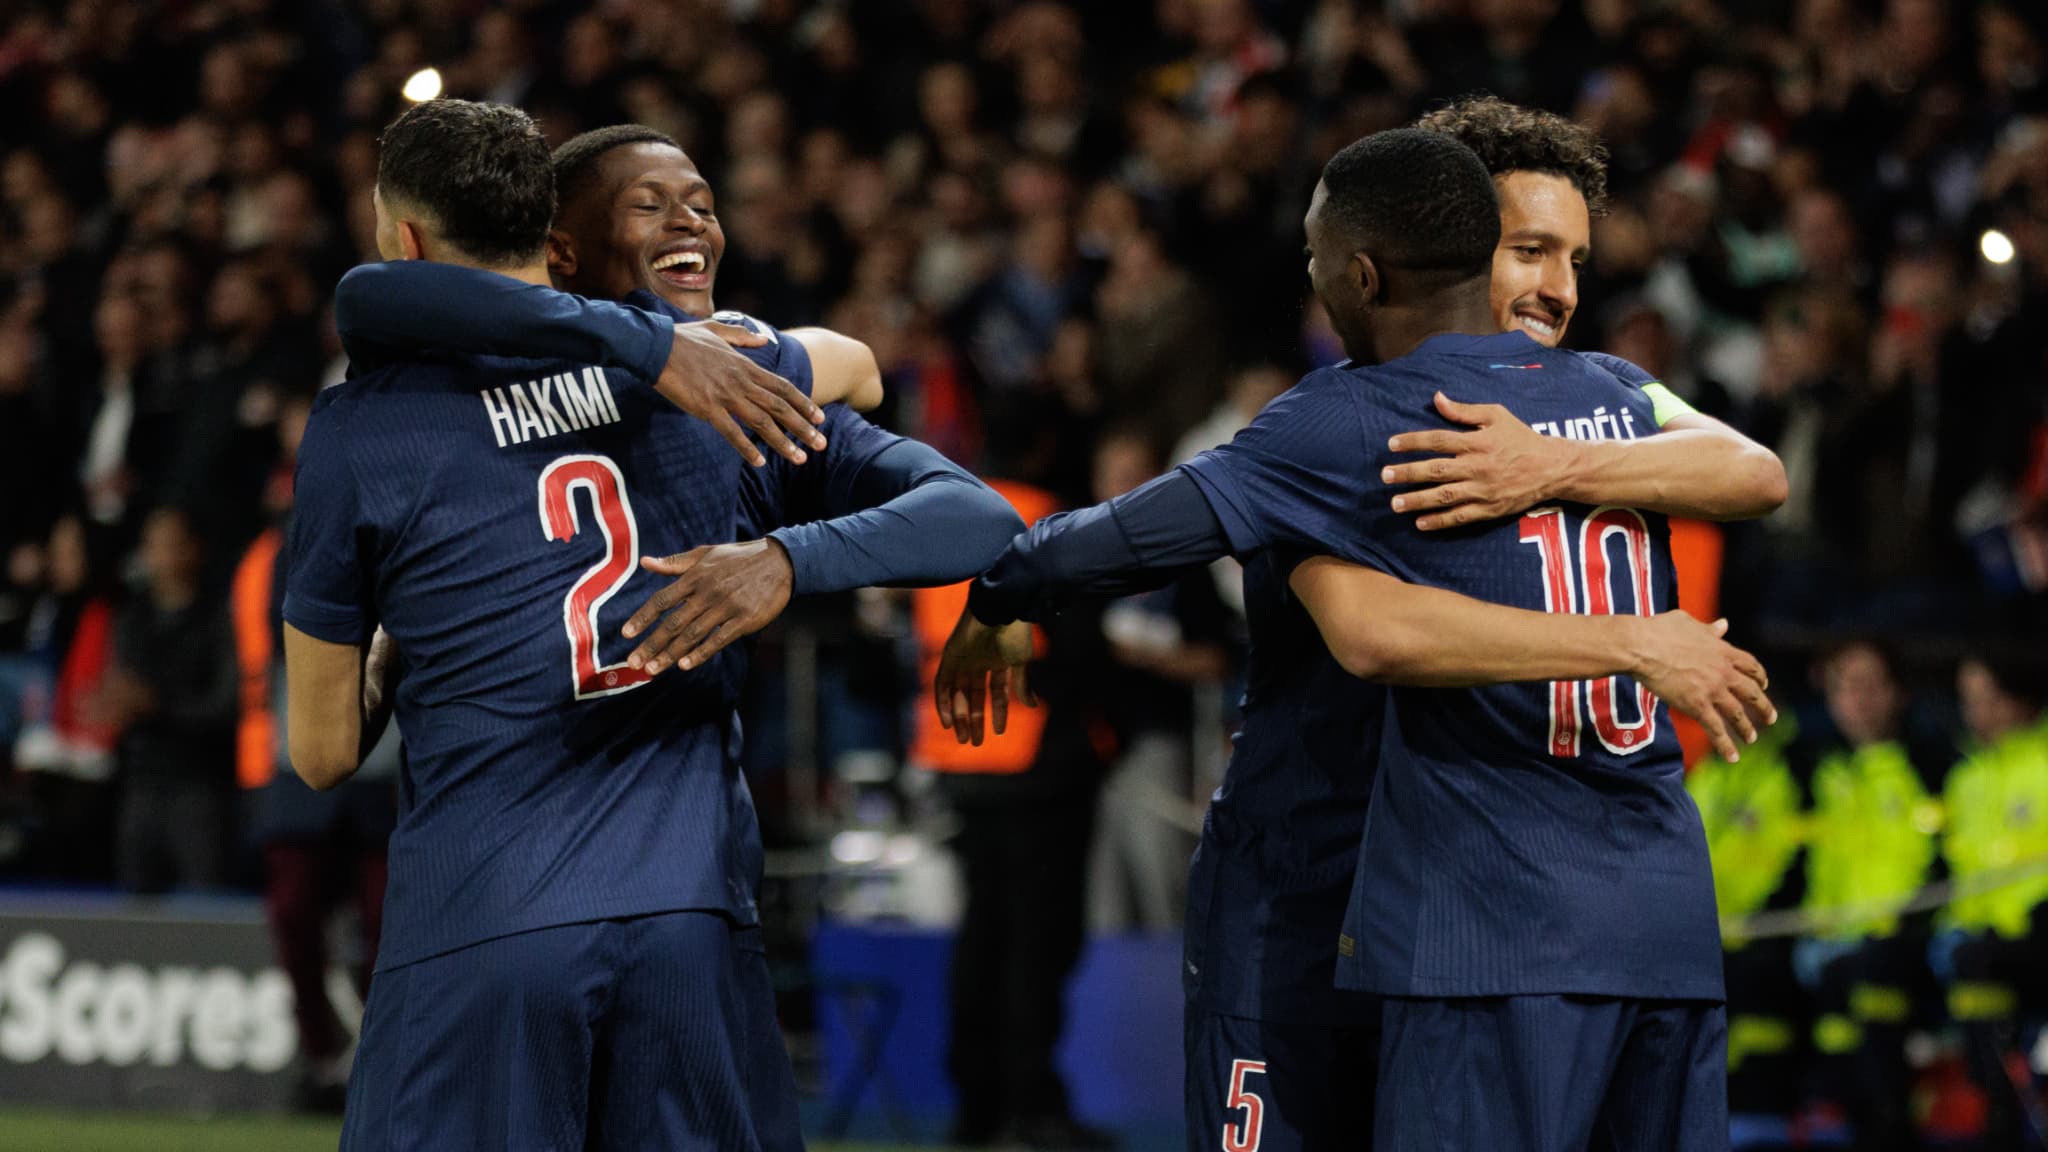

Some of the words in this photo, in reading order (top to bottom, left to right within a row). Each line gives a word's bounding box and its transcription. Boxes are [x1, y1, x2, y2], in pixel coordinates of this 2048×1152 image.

[480, 366, 621, 448] HAKIMI
[538, 454, 652, 701] 2
[1519, 505, 1659, 756] 10
[0, 934, 297, 1071] Scores
[1222, 1059, 1267, 1152] 5
